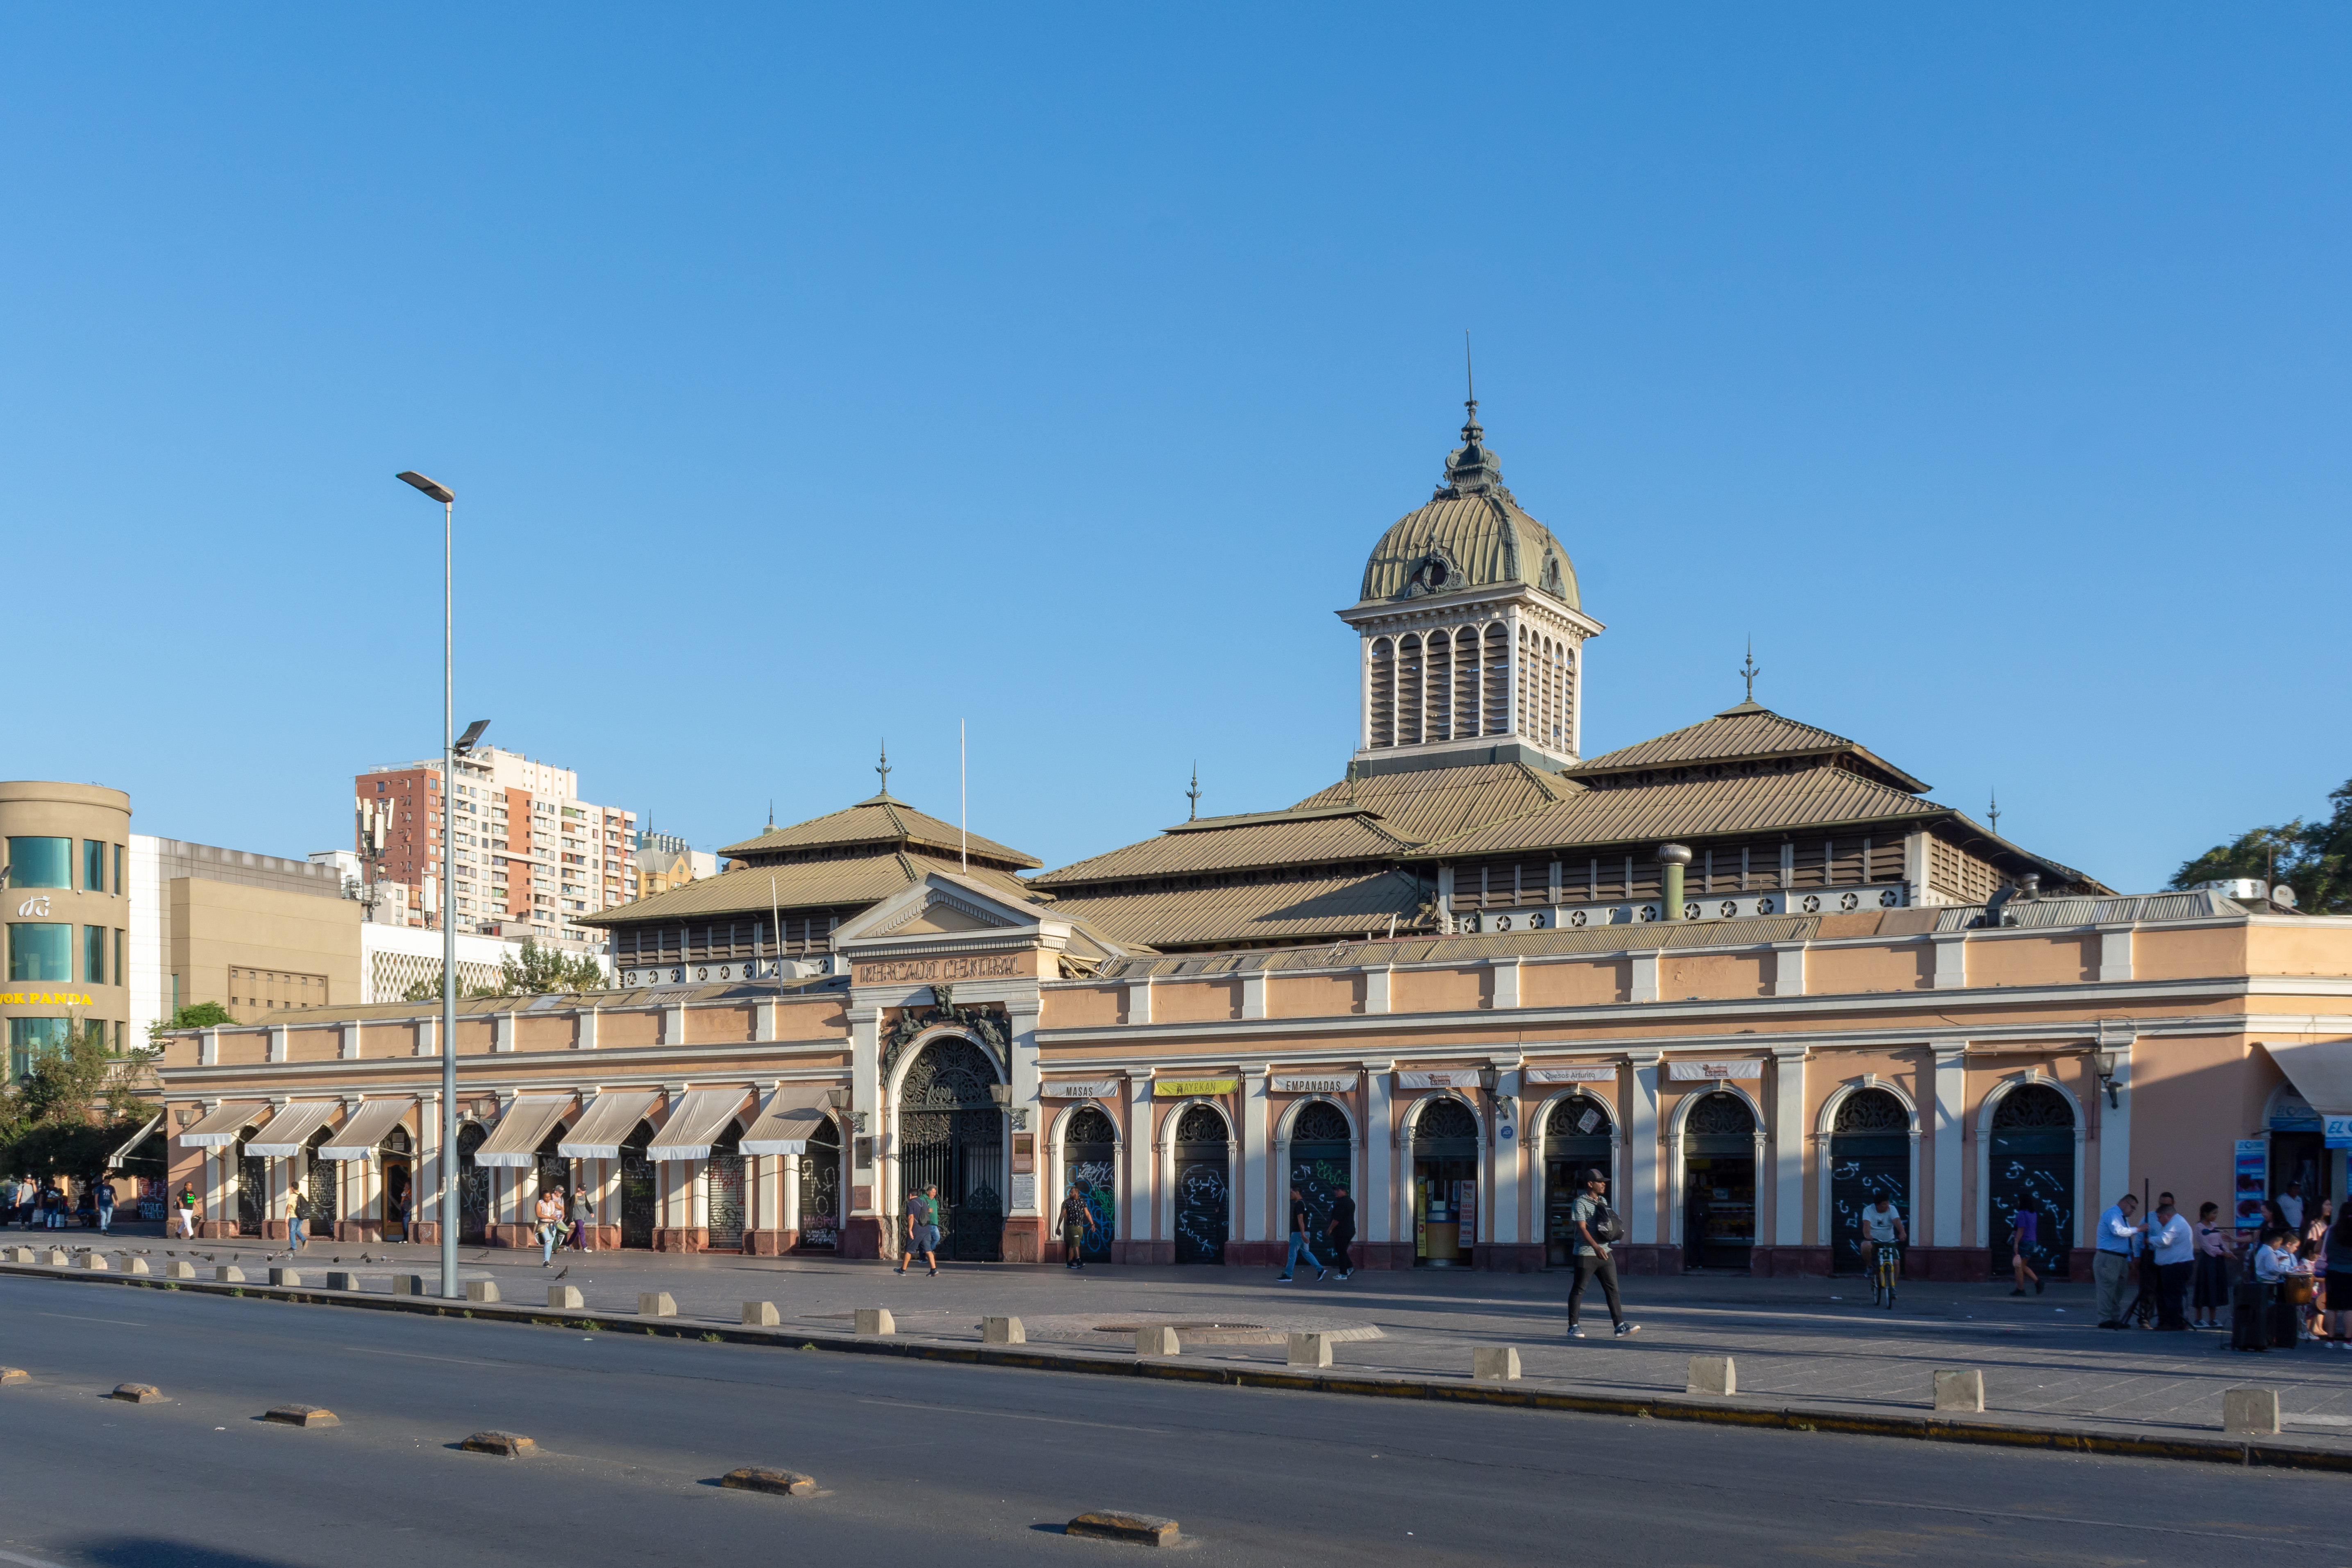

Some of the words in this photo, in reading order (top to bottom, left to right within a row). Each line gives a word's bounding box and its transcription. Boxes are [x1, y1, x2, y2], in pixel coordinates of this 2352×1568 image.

[860, 960, 940, 983] MERCADO
[944, 955, 1024, 978] CENTRAL
[0, 993, 25, 1004] OK
[29, 993, 93, 1005] PANDA
[1066, 1087, 1092, 1096] MASAS
[1287, 1081, 1340, 1091] EMPANADAS
